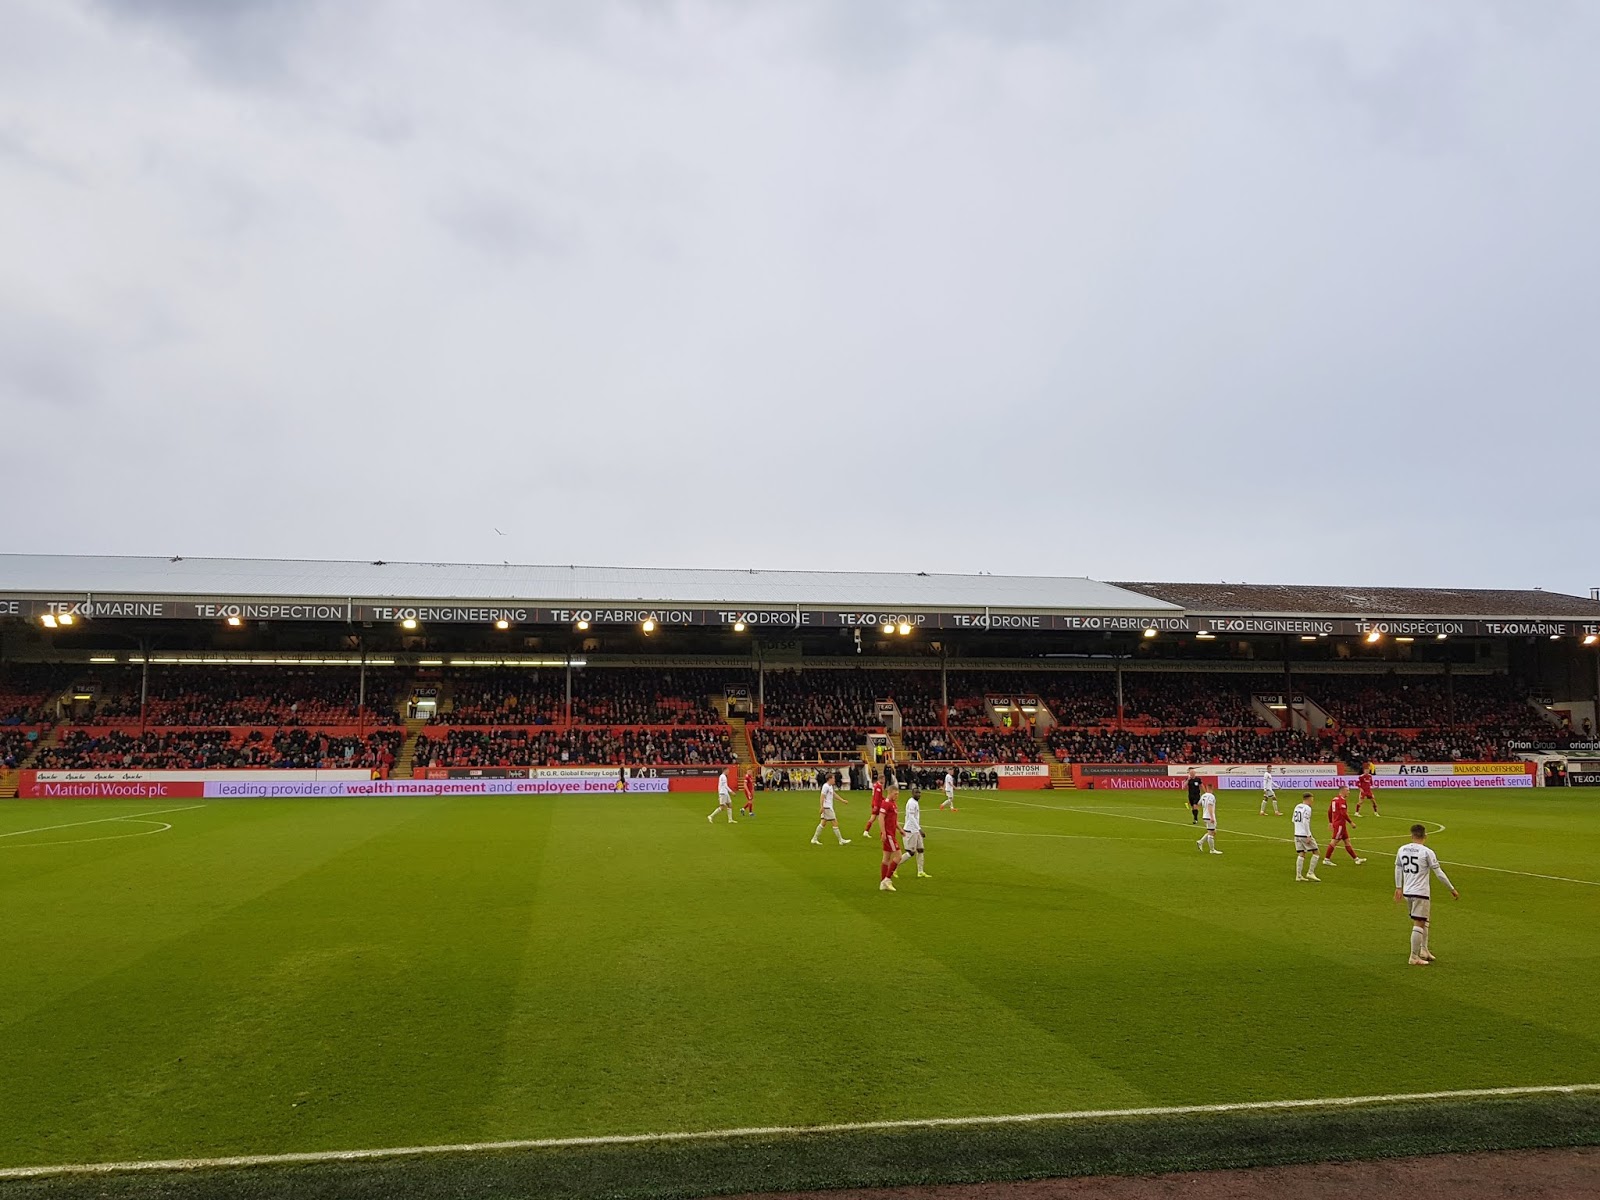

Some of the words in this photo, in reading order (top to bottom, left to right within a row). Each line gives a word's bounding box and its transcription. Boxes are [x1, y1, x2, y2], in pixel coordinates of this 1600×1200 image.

[48, 603, 93, 615] TEXO
[96, 604, 163, 616] MARINE
[195, 604, 240, 617] TEXO
[242, 605, 342, 619] INSPECTION
[373, 607, 416, 620] TEXO
[418, 608, 527, 622] ENGINEERING
[551, 609, 592, 622] TEXO
[595, 610, 693, 623] FABRICATION
[719, 611, 758, 624] TEXO
[759, 612, 810, 625] DRONE
[839, 613, 876, 625] TEXO
[878, 613, 926, 626] GROUP
[953, 615, 990, 627] TEXO
[992, 616, 1040, 628] DRONE
[1064, 617, 1101, 629] TEXO
[1103, 617, 1190, 630] FABRICATION
[1209, 619, 1245, 631] TEXO
[1246, 620, 1334, 633] ENGINEERING
[1355, 622, 1389, 633] TEXO
[1390, 623, 1463, 635] INSPECTION
[1486, 623, 1519, 635] TEXO
[1519, 624, 1566, 636] MARINE
[1507, 740, 1532, 749] Orion
[1454, 765, 1489, 773] BALMORAL
[1490, 765, 1524, 773] OFFSHORE
[1110, 777, 1147, 788] Mattioli
[1149, 778, 1180, 788] Woods
[1228, 777, 1262, 789] leading
[1304, 777, 1313, 787] of
[1315, 777, 1345, 788] wealth
[1409, 777, 1425, 787] and
[1427, 777, 1471, 789] employee
[1473, 777, 1505, 787] benefit
[1573, 775, 1595, 783] TEXO
[45, 783, 98, 795] Mattioli
[101, 784, 145, 795] Woods
[148, 783, 167, 798] plc
[219, 783, 266, 797] leading
[271, 783, 325, 797] provider
[330, 783, 343, 794] of
[346, 782, 392, 794] wealth
[397, 782, 486, 795] management
[489, 782, 513, 792] and
[516, 781, 580, 793] employee
[1402, 855, 1419, 874] 25
